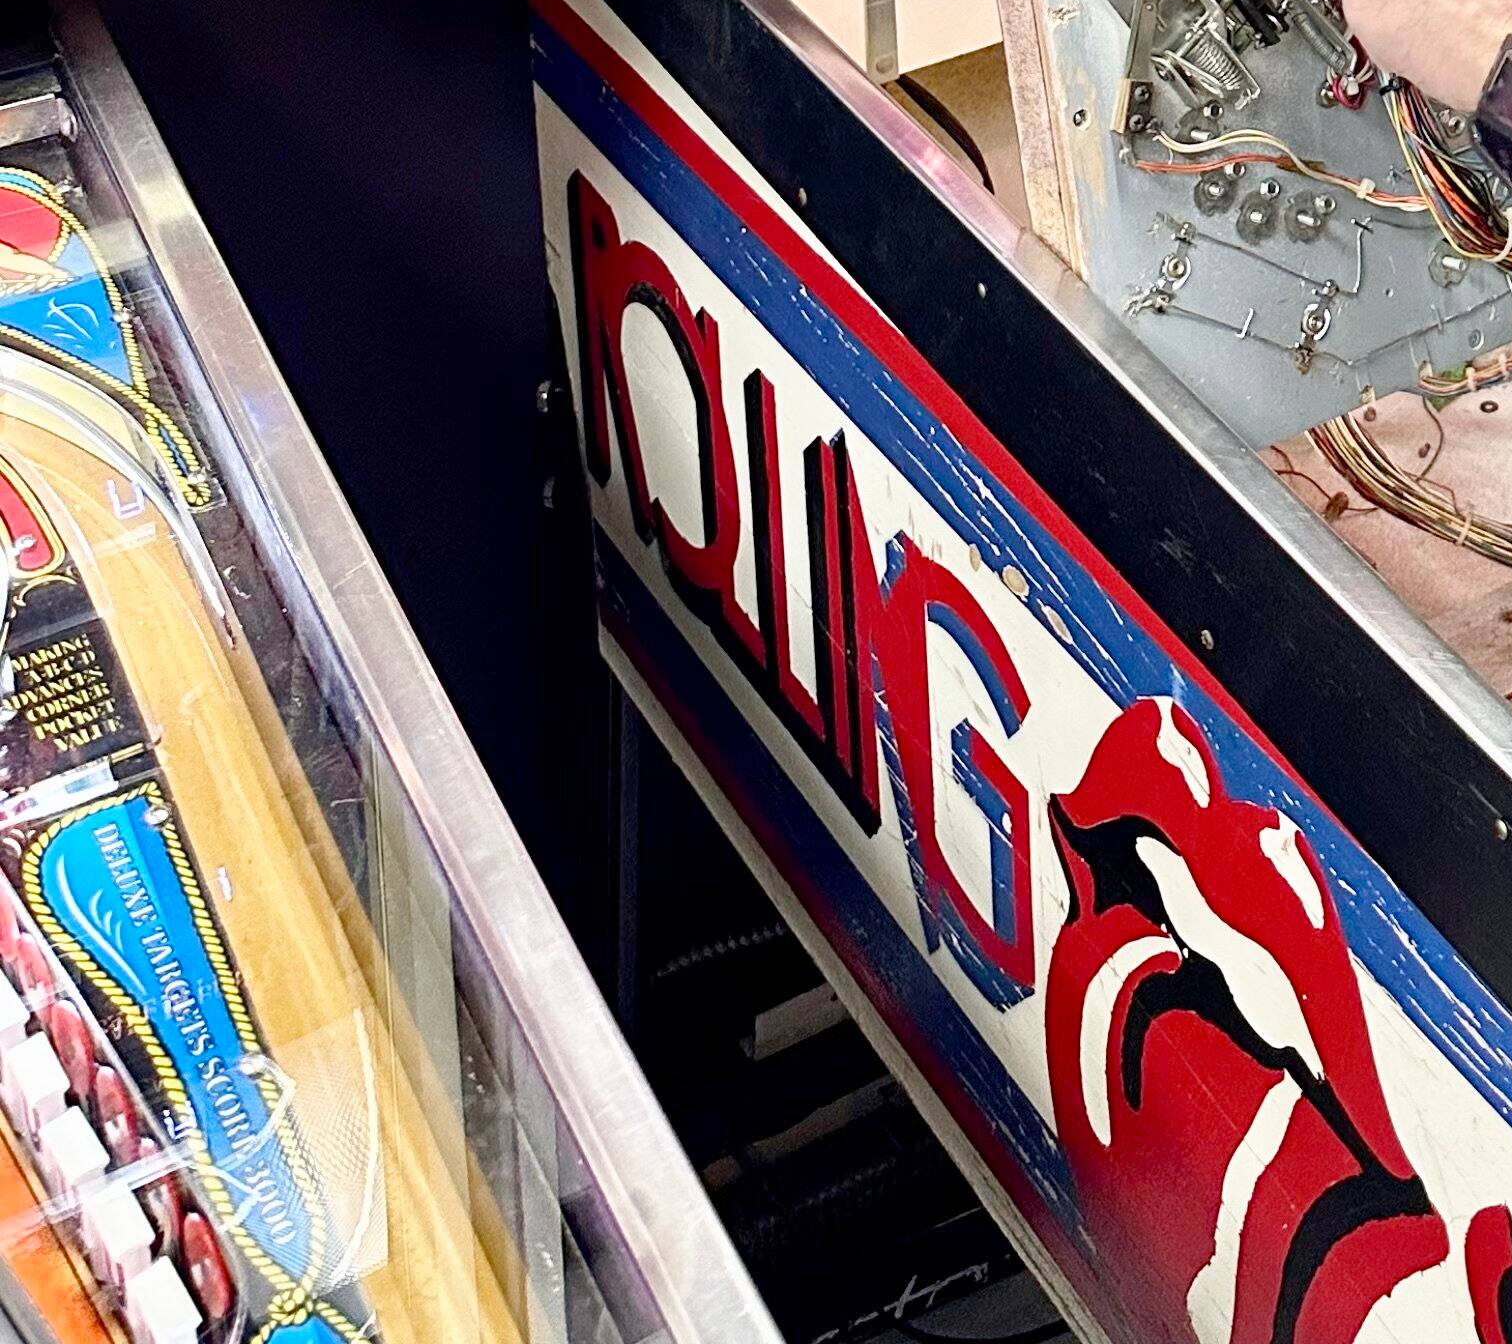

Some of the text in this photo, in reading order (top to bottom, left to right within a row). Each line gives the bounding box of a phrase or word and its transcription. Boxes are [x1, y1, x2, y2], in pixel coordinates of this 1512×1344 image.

[26, 682, 111, 722] CORNER
[93, 822, 149, 928] DELUXE
[141, 926, 216, 1057] TARGETS
